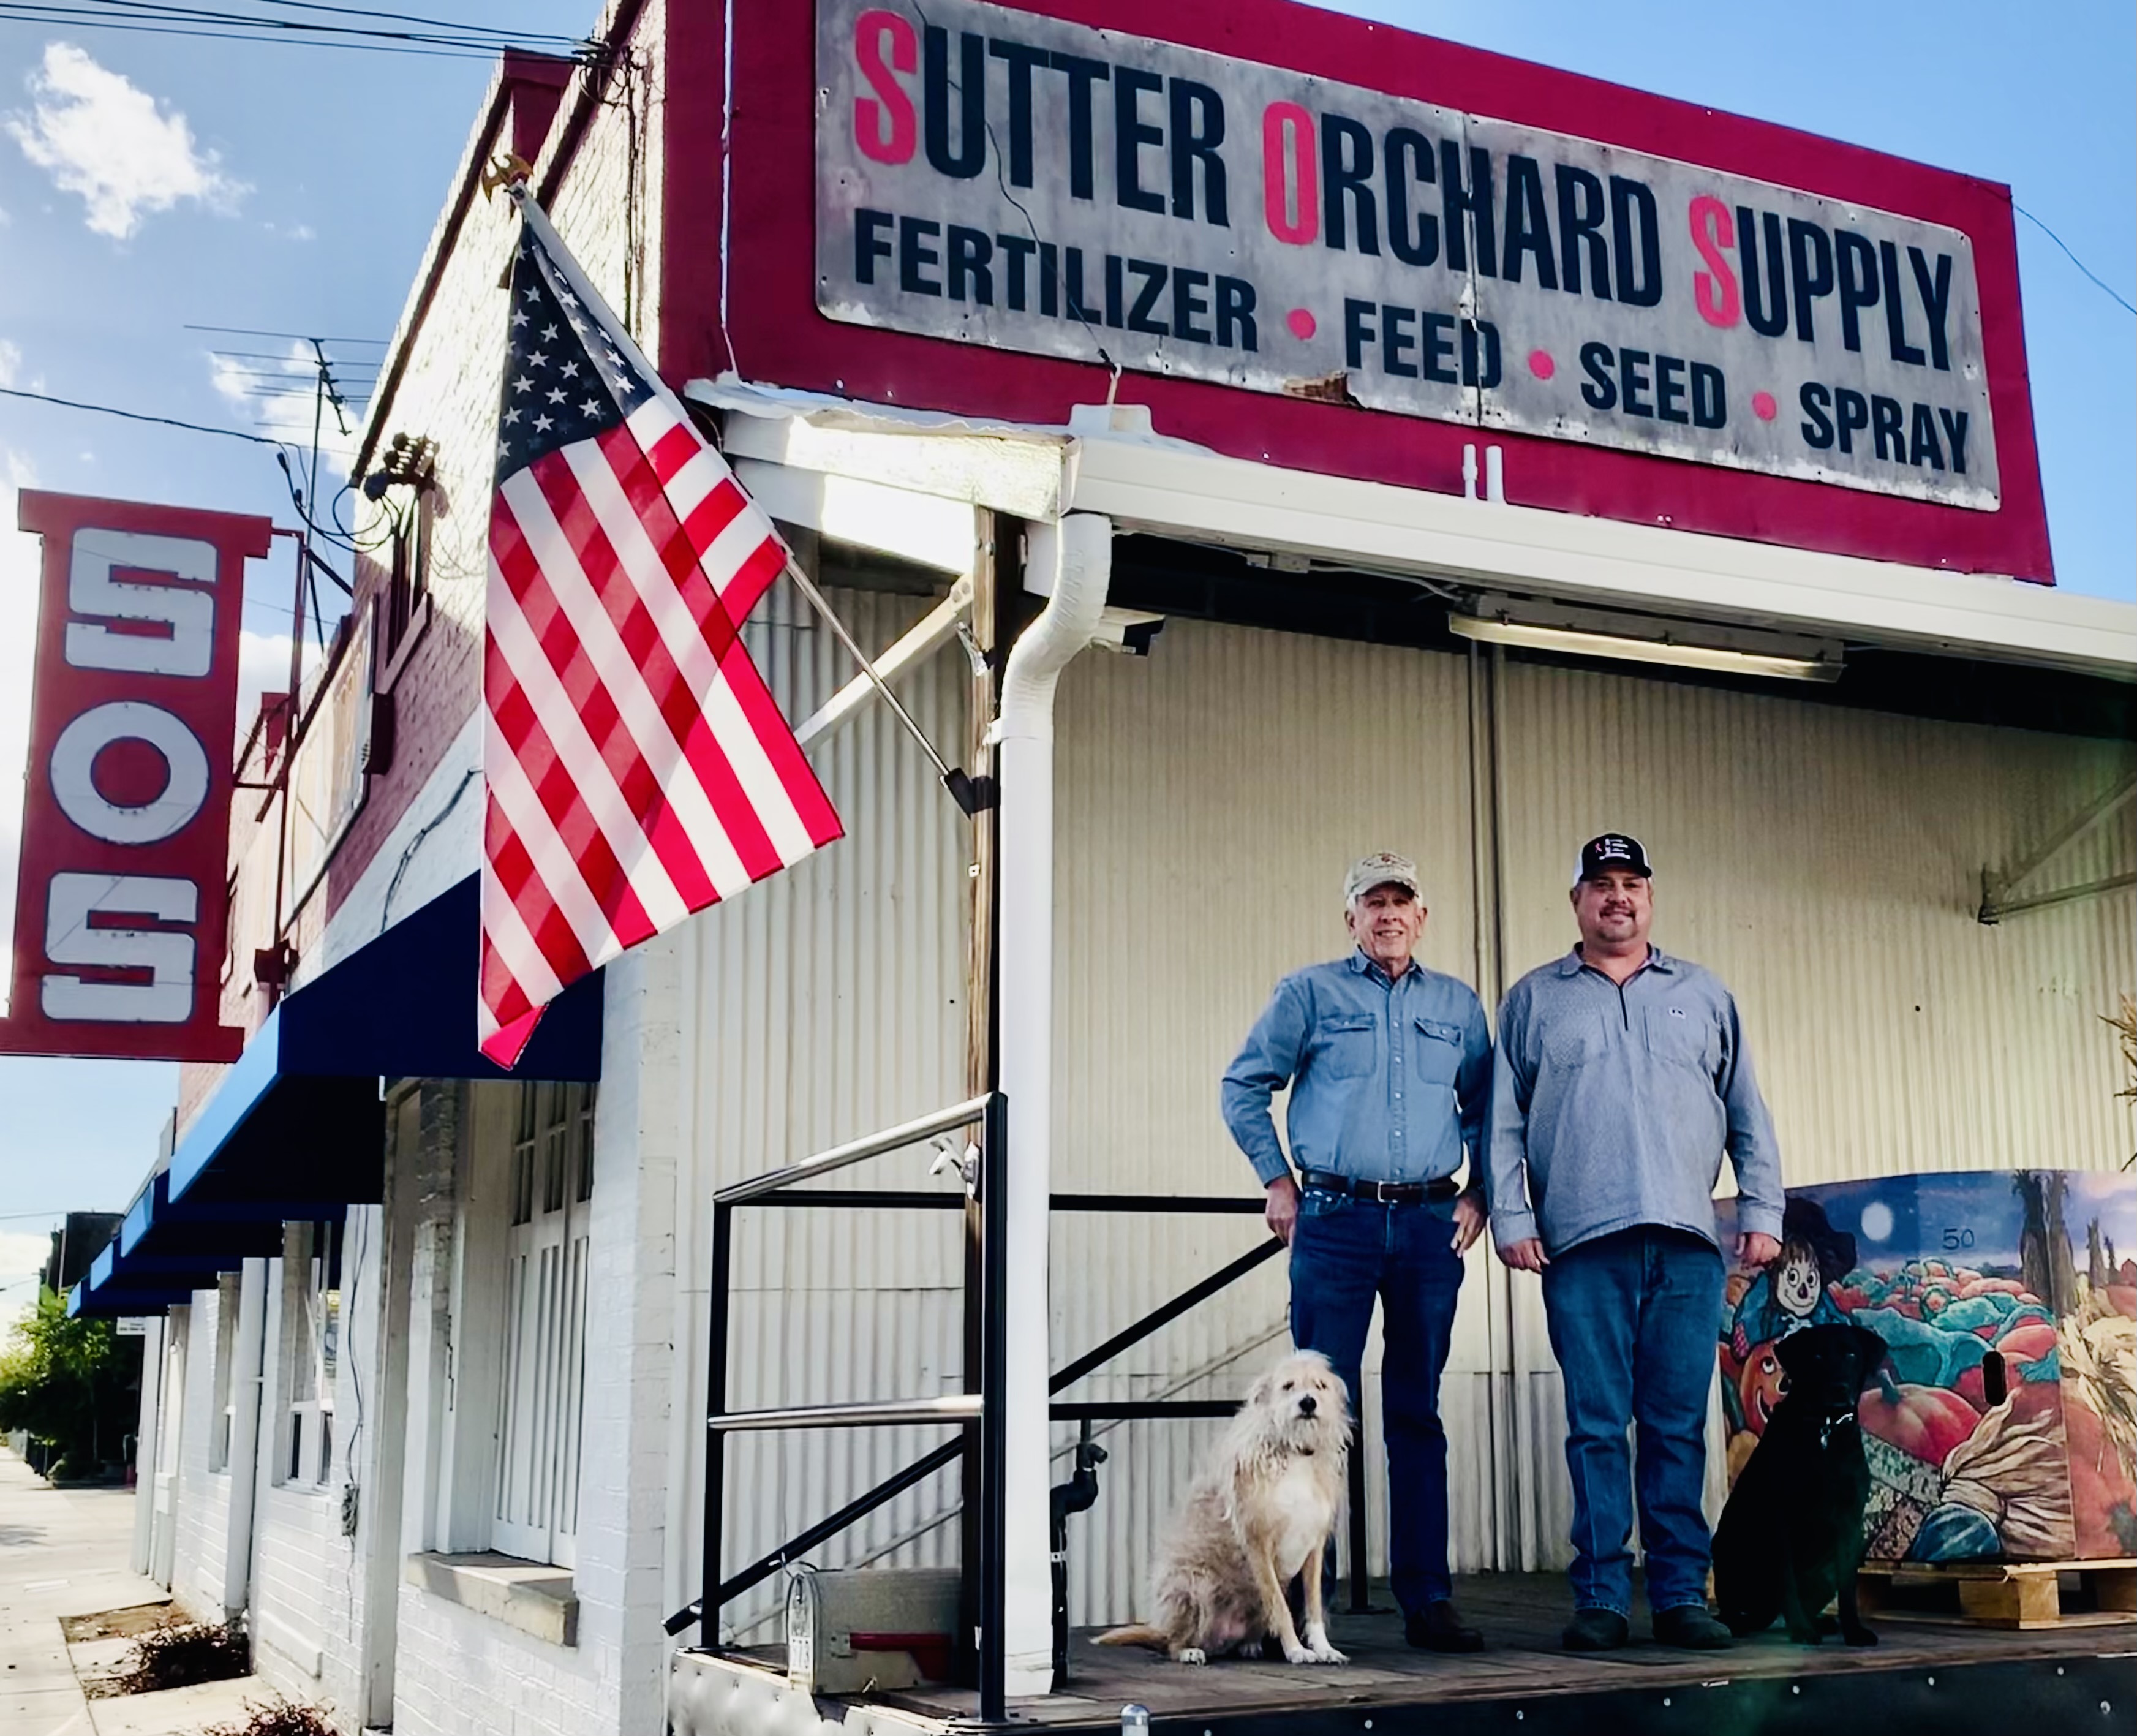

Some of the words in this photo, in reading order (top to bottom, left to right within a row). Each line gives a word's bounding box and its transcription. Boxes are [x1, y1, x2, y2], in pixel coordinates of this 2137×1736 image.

[854, 208, 1259, 353] FERTILIZER
[1344, 297, 1502, 390] FEED
[1580, 341, 1727, 430] SEED
[1799, 382, 1969, 475] SPRAY
[855, 9, 1231, 228] SUTTER
[1262, 100, 1662, 308] ORCHARD
[1689, 195, 1953, 371] SUPPLY
[41, 527, 217, 1022] SOS
[1942, 1228, 1975, 1250] 50
